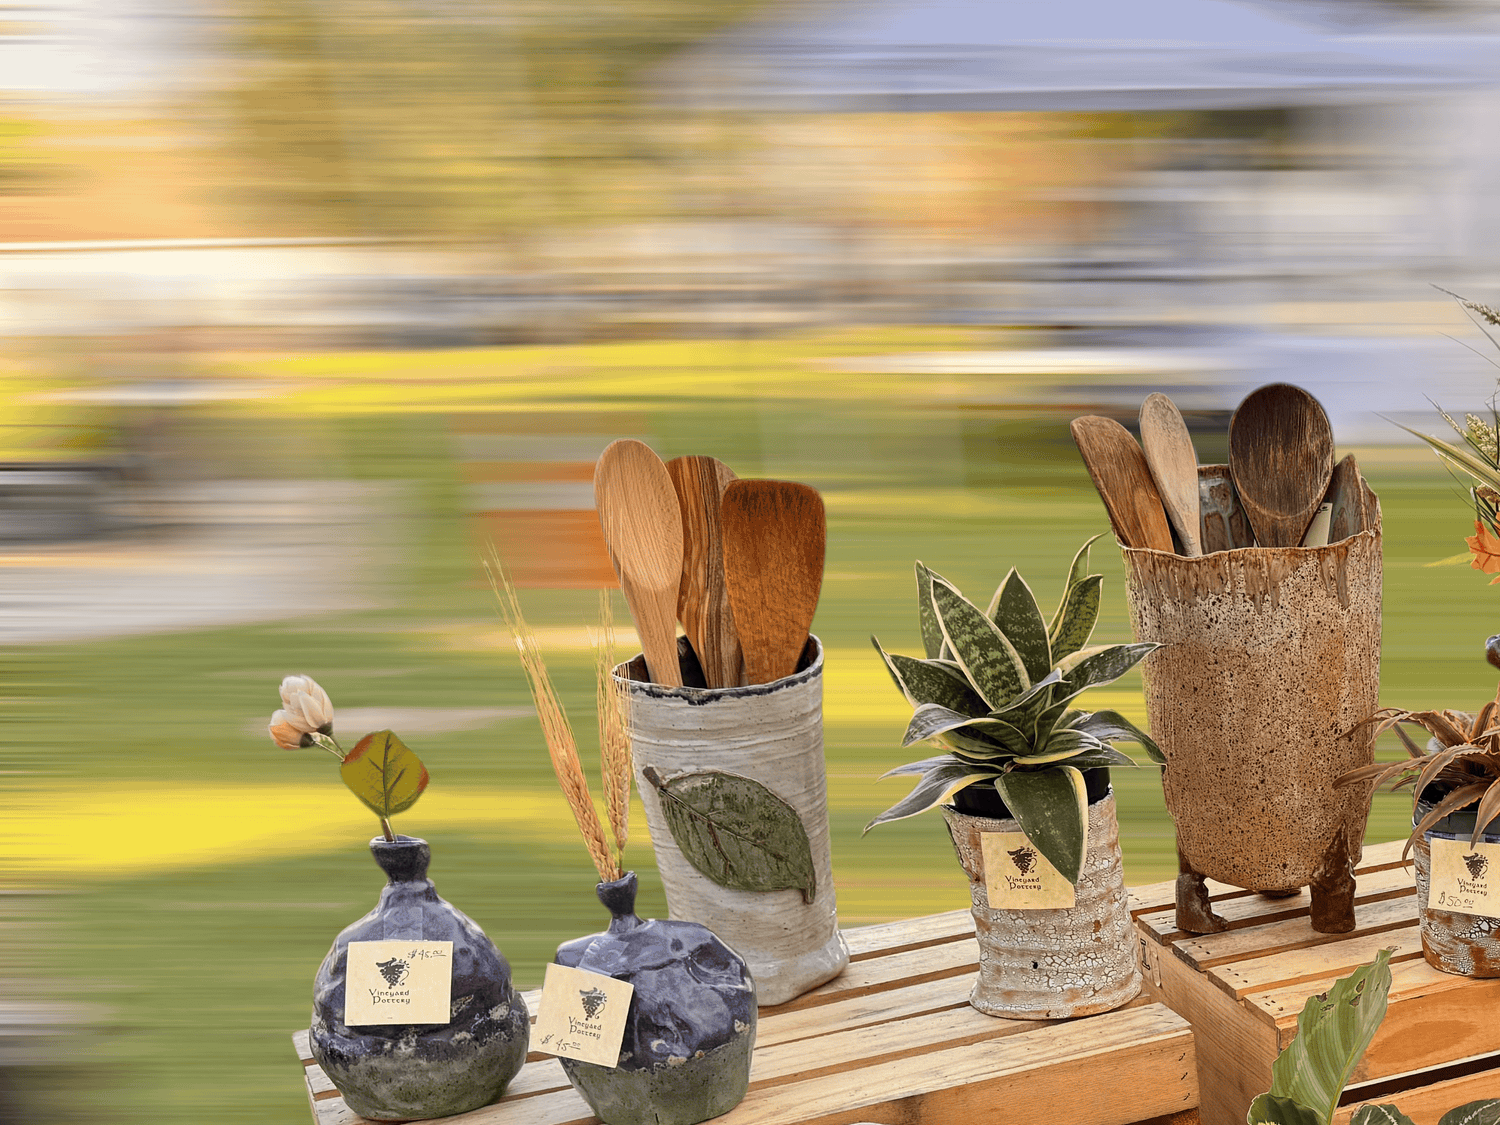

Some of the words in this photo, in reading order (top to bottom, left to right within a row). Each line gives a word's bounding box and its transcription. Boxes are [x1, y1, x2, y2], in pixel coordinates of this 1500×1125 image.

[1005, 875, 1040, 884] Vineyard
[1457, 878, 1488, 890] Vineyard
[1010, 881, 1042, 891] Pottery
[1459, 885, 1488, 897] Pottery
[369, 989, 409, 998] Vineyard
[373, 996, 410, 1005] Pottery
[569, 1016, 602, 1031] Vineyard
[569, 1024, 601, 1040] Pottery
